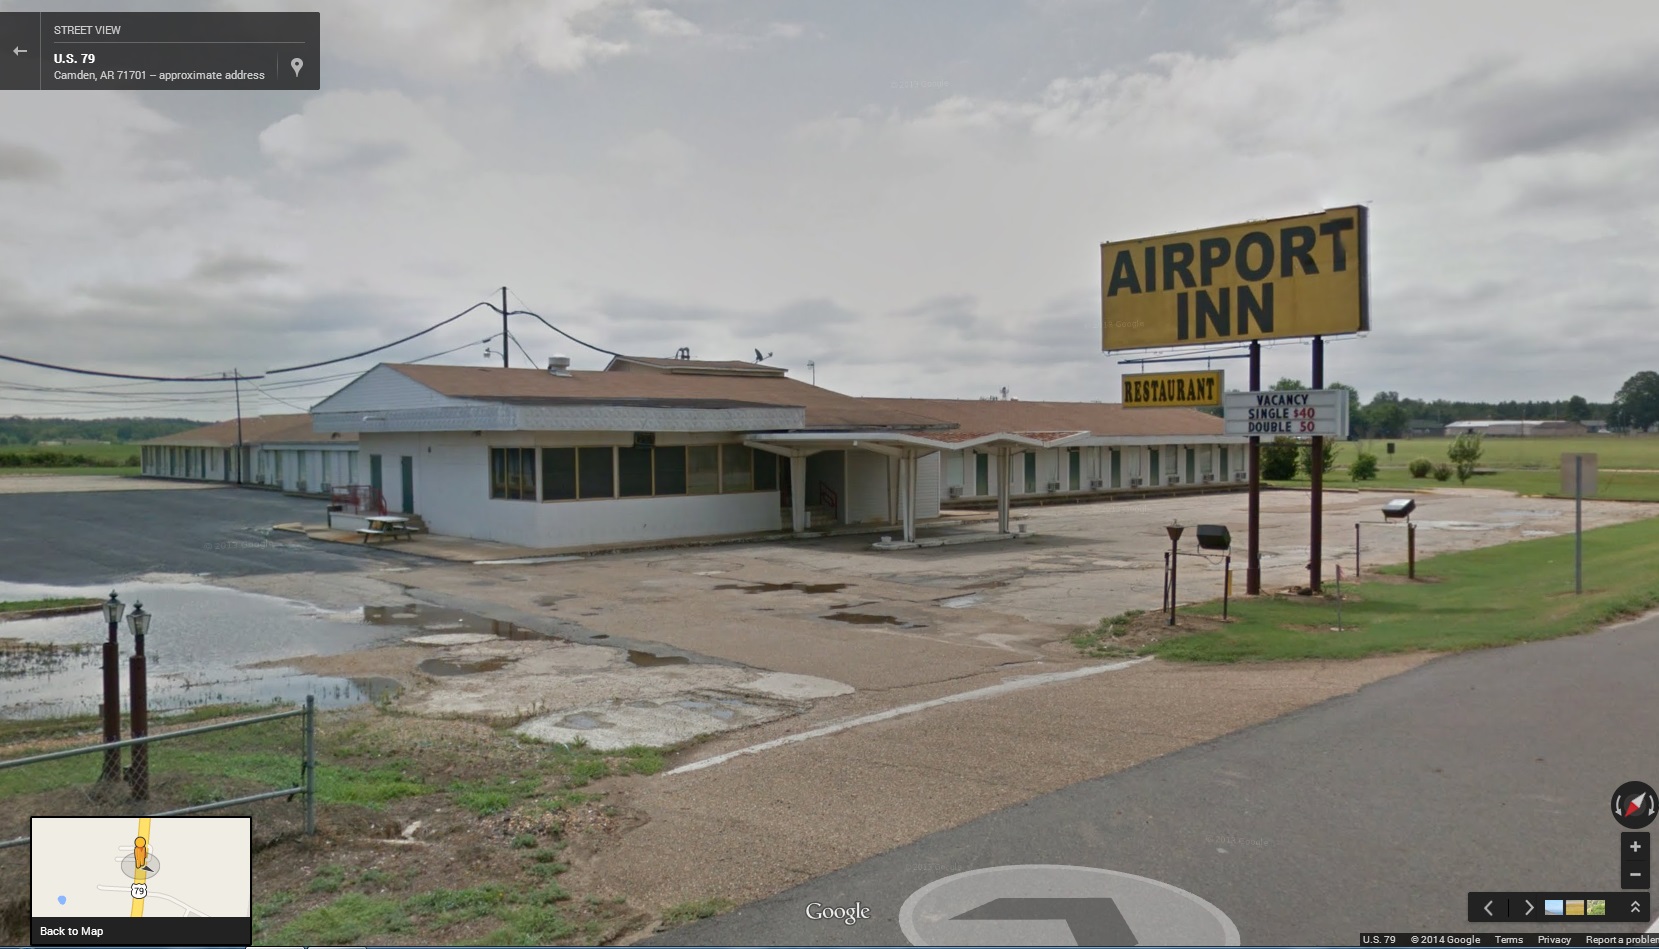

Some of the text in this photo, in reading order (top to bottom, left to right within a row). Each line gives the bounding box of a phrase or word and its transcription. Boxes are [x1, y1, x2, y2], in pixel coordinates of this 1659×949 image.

[1107, 218, 1354, 297] AIRPORT
[1177, 282, 1274, 340] INN
[1124, 377, 1215, 403] RESTAURANT
[1256, 394, 1309, 406] VACANCY
[1248, 407, 1315, 420] SINGLE $40
[1248, 420, 1315, 433] DOUBLE 50
